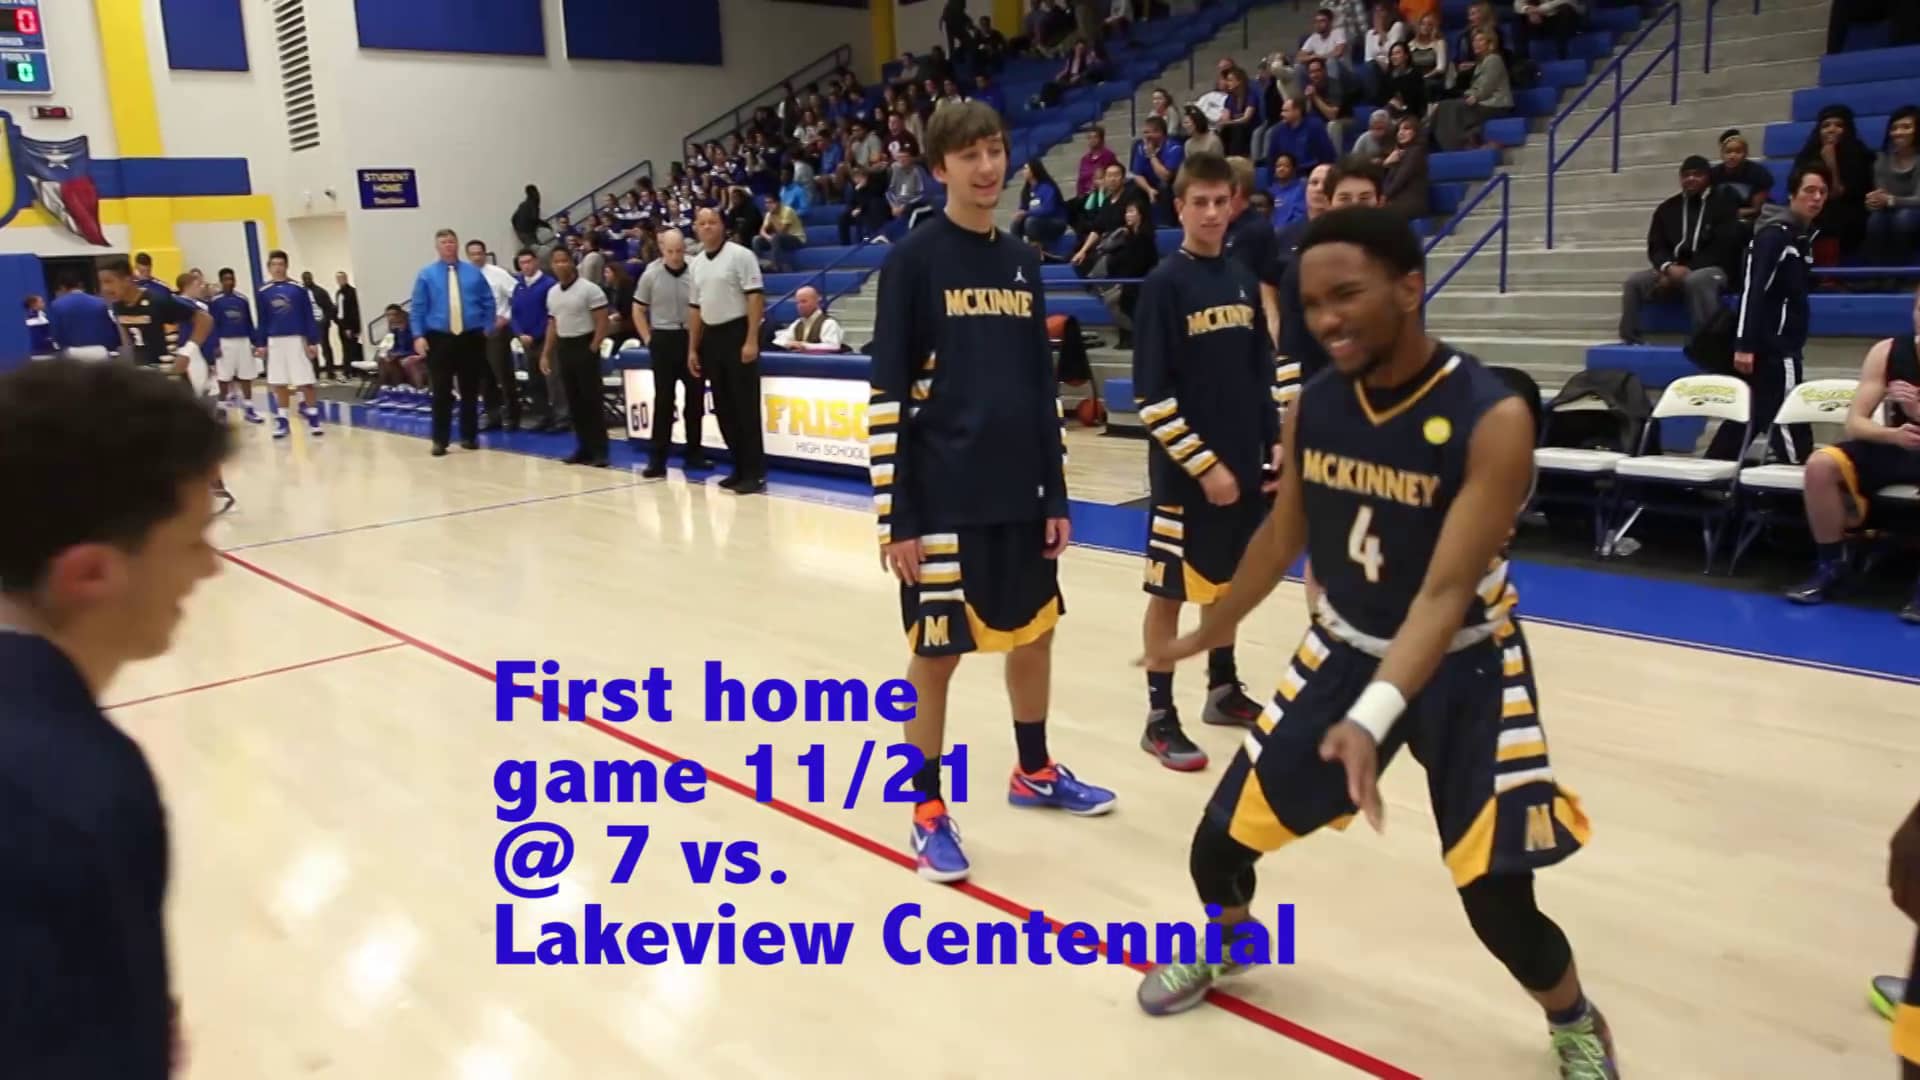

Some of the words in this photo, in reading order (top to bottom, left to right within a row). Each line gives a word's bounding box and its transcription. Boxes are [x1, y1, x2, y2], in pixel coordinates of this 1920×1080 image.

[16, 8, 39, 33] 0
[17, 62, 35, 82] 0
[944, 287, 1033, 318] MCKINNE
[795, 441, 820, 454] HIGH
[823, 444, 867, 460] SCHOOL
[1303, 448, 1441, 507] MCKINNEY
[1348, 504, 1385, 583] 4
[923, 614, 951, 647] M
[1525, 803, 1557, 851] M
